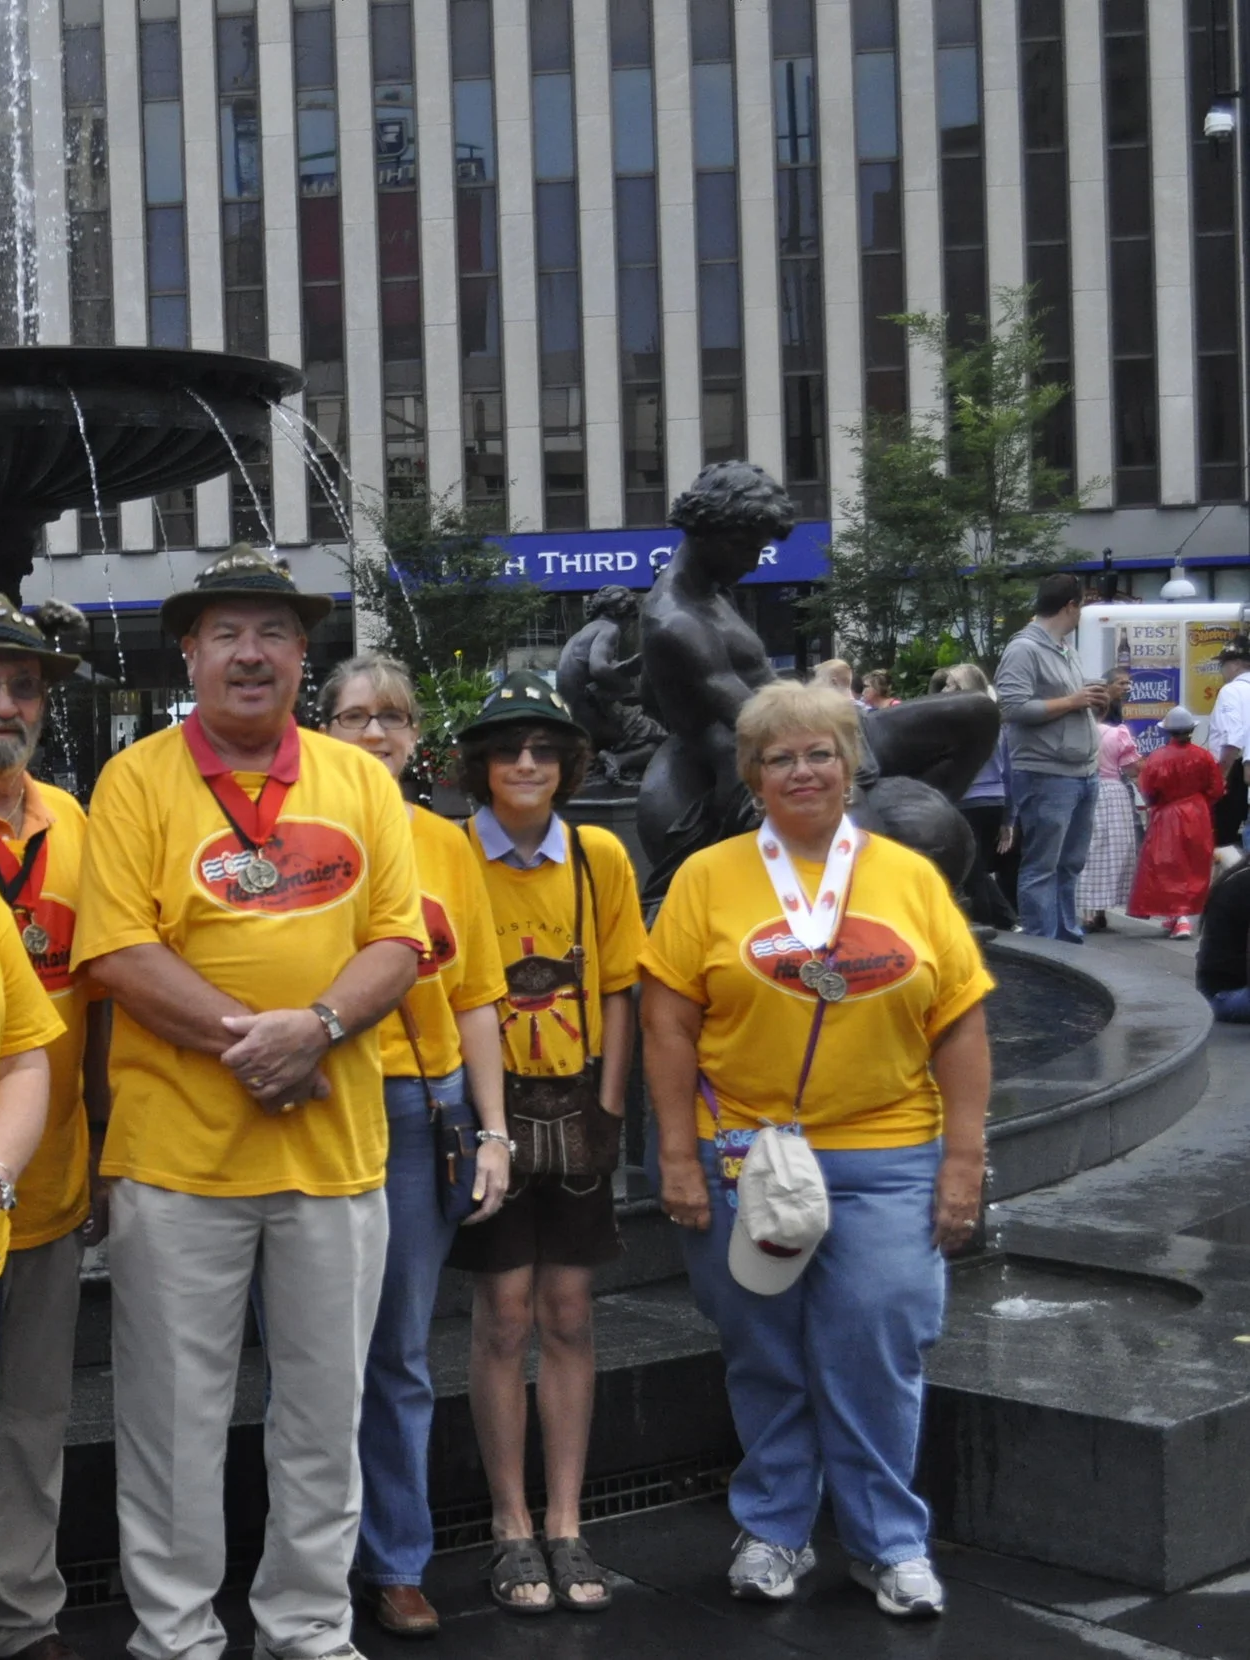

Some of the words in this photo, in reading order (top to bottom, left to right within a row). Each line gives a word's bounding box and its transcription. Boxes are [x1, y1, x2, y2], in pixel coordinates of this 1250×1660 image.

[538, 551, 638, 574] THIRD
[1133, 626, 1177, 638] FEST
[1133, 644, 1177, 656] BEST
[1127, 680, 1171, 692] SAMUEL
[1128, 690, 1168, 702] ADAMS
